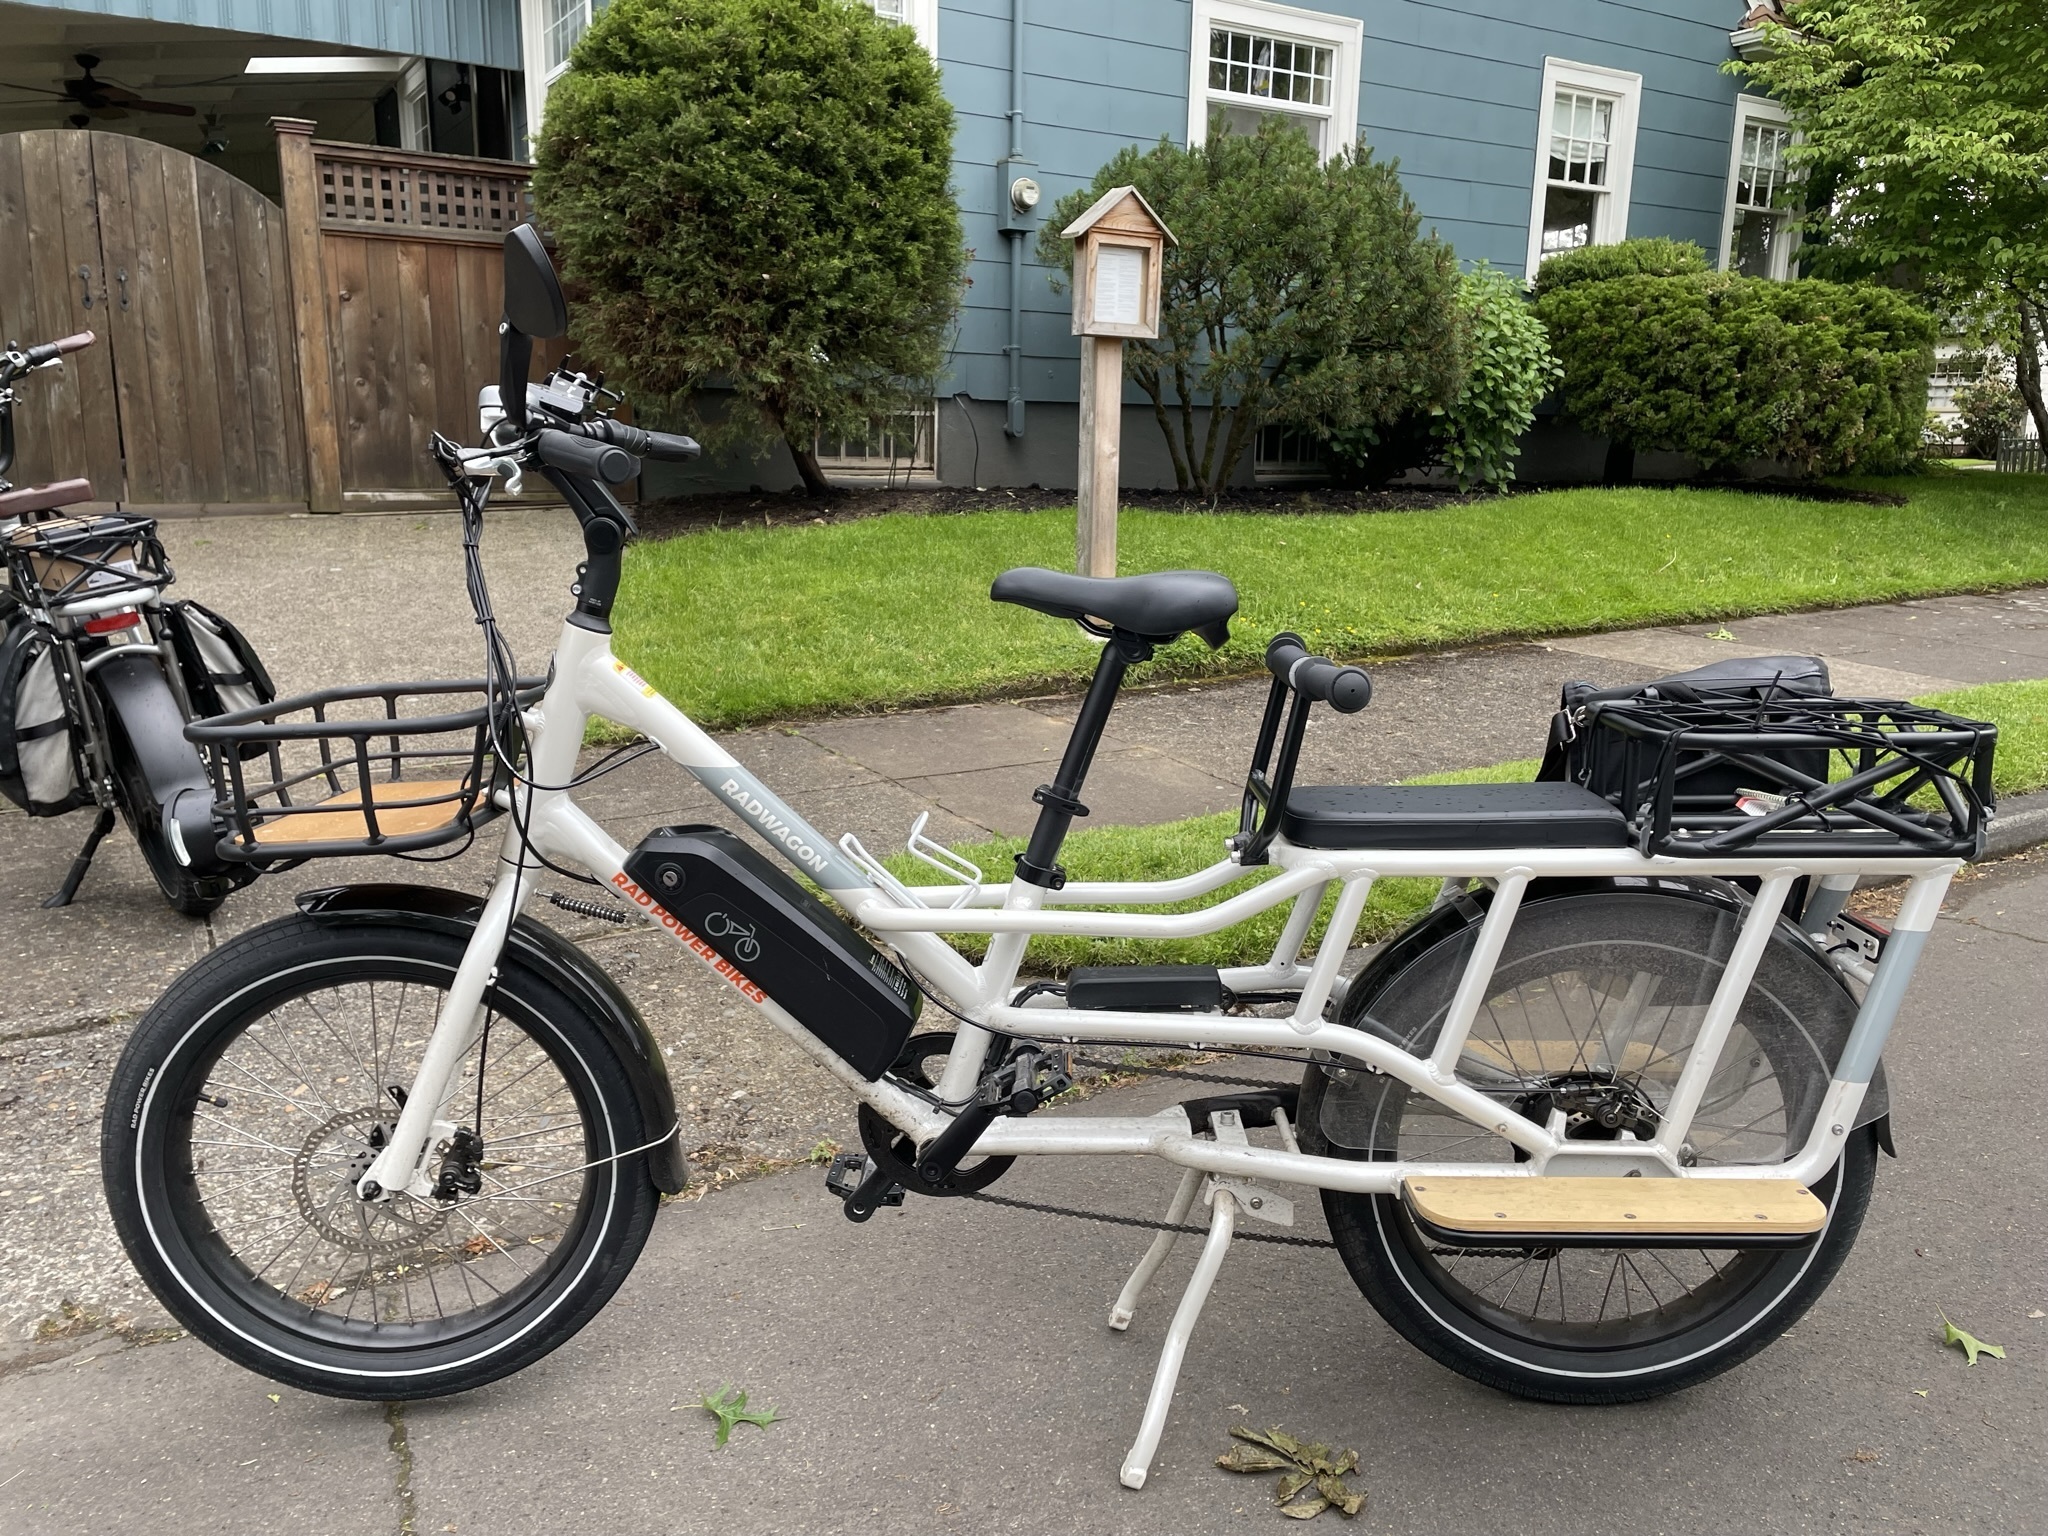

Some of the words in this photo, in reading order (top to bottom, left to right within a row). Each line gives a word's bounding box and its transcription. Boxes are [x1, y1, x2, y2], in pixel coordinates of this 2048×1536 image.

[719, 778, 829, 873] RADWAGON
[611, 872, 652, 907] RAD
[649, 902, 717, 962] POWER
[713, 958, 768, 1004] BIKES
[134, 1088, 146, 1113] POWER
[142, 1068, 154, 1088] BIKES
